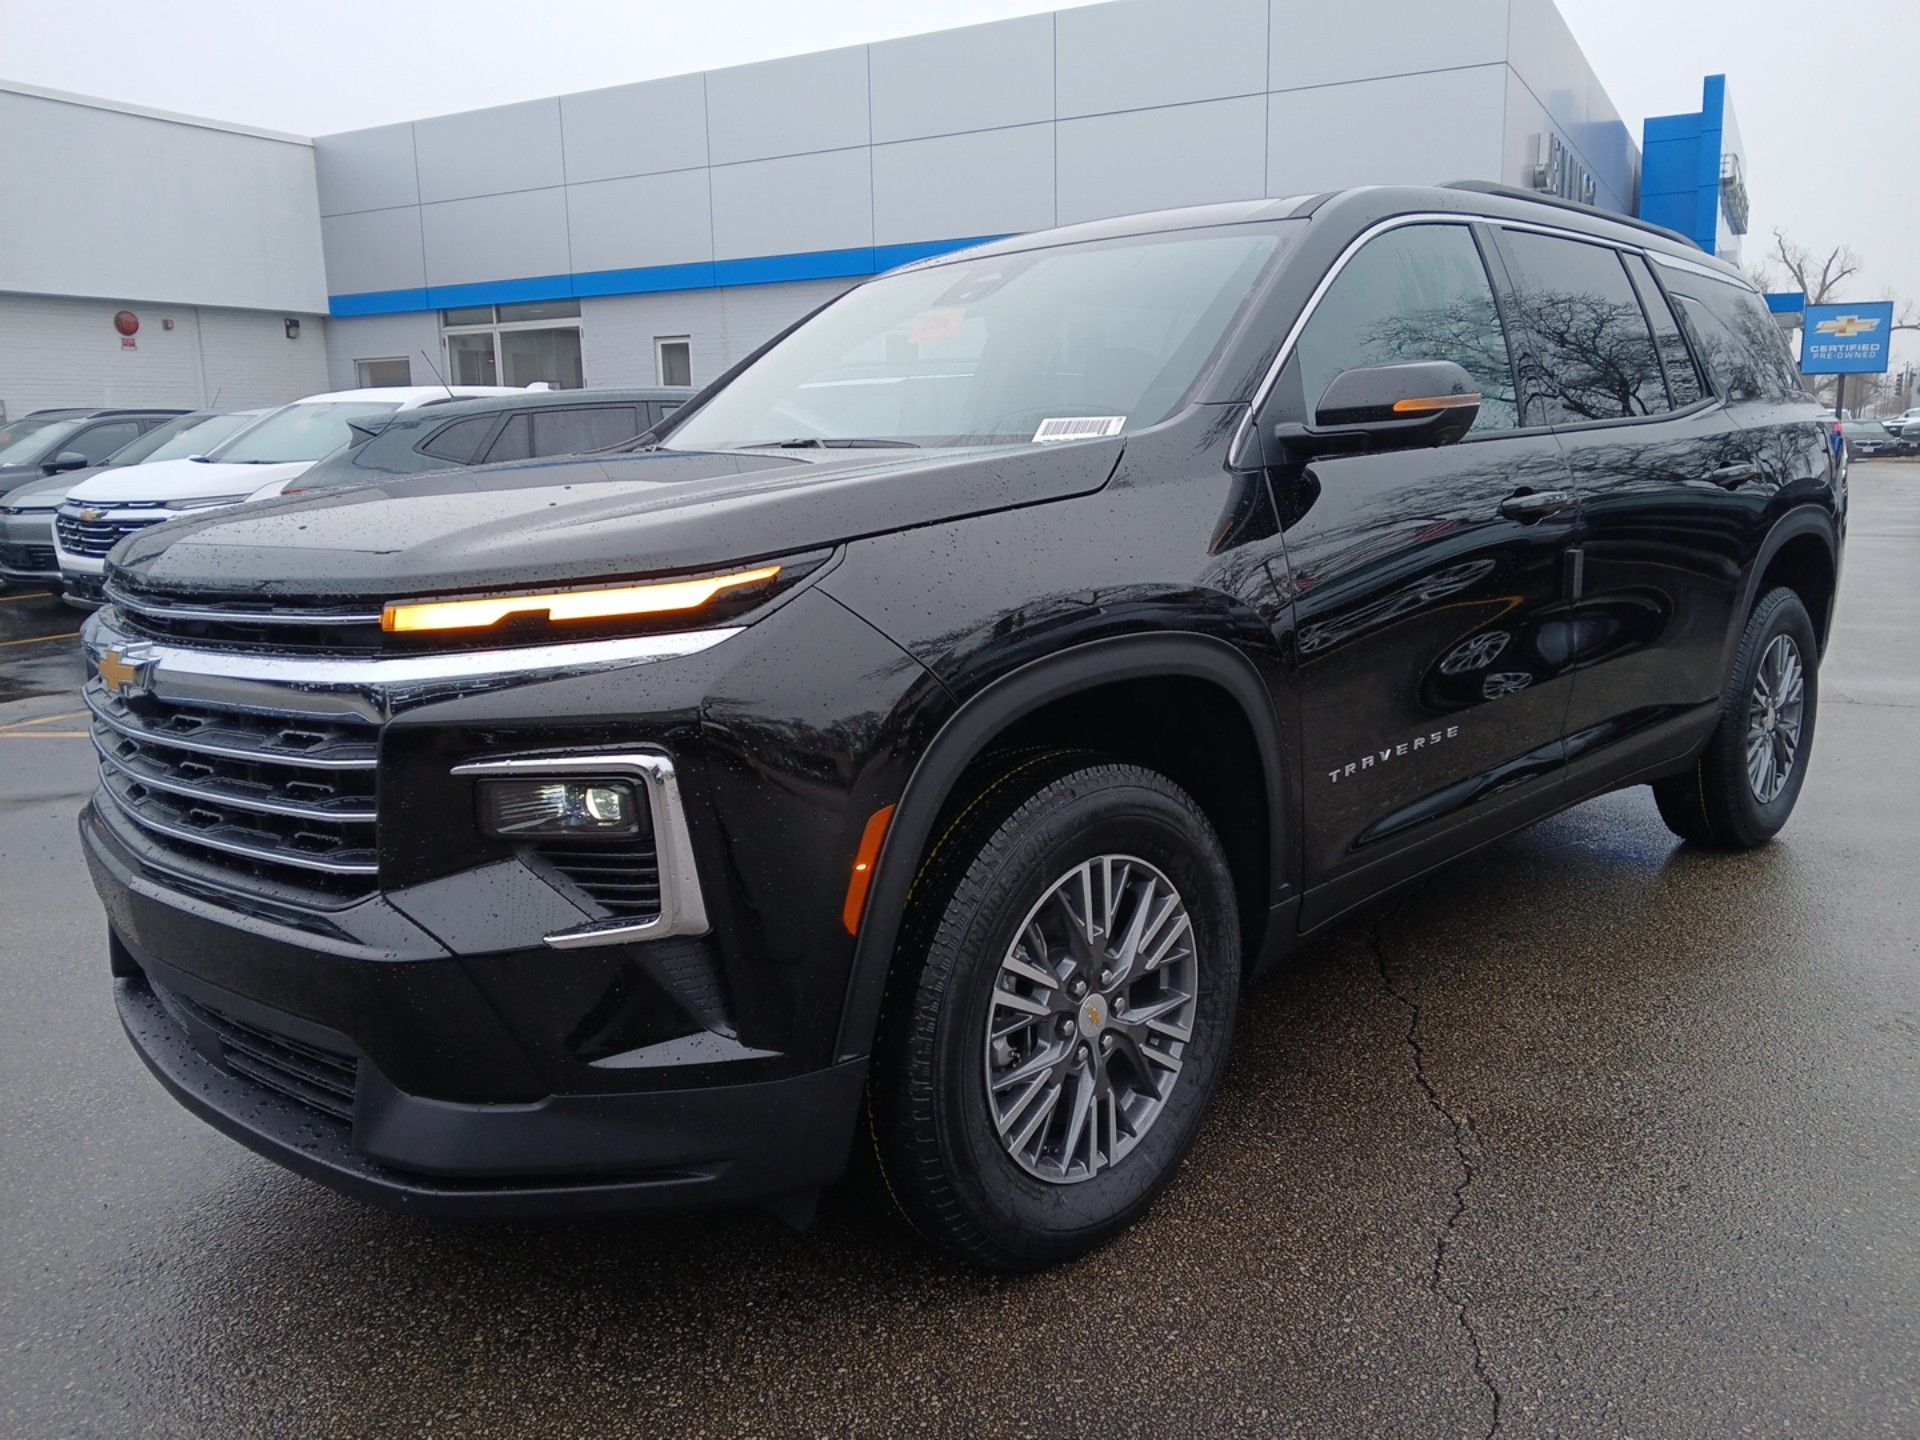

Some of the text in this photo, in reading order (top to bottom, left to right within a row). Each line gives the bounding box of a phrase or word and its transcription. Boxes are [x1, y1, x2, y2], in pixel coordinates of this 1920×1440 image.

[1810, 344, 1880, 353] CERTIFIED
[1812, 351, 1877, 360] PRE-OWNED
[1328, 725, 1459, 783] TRAVERSE
